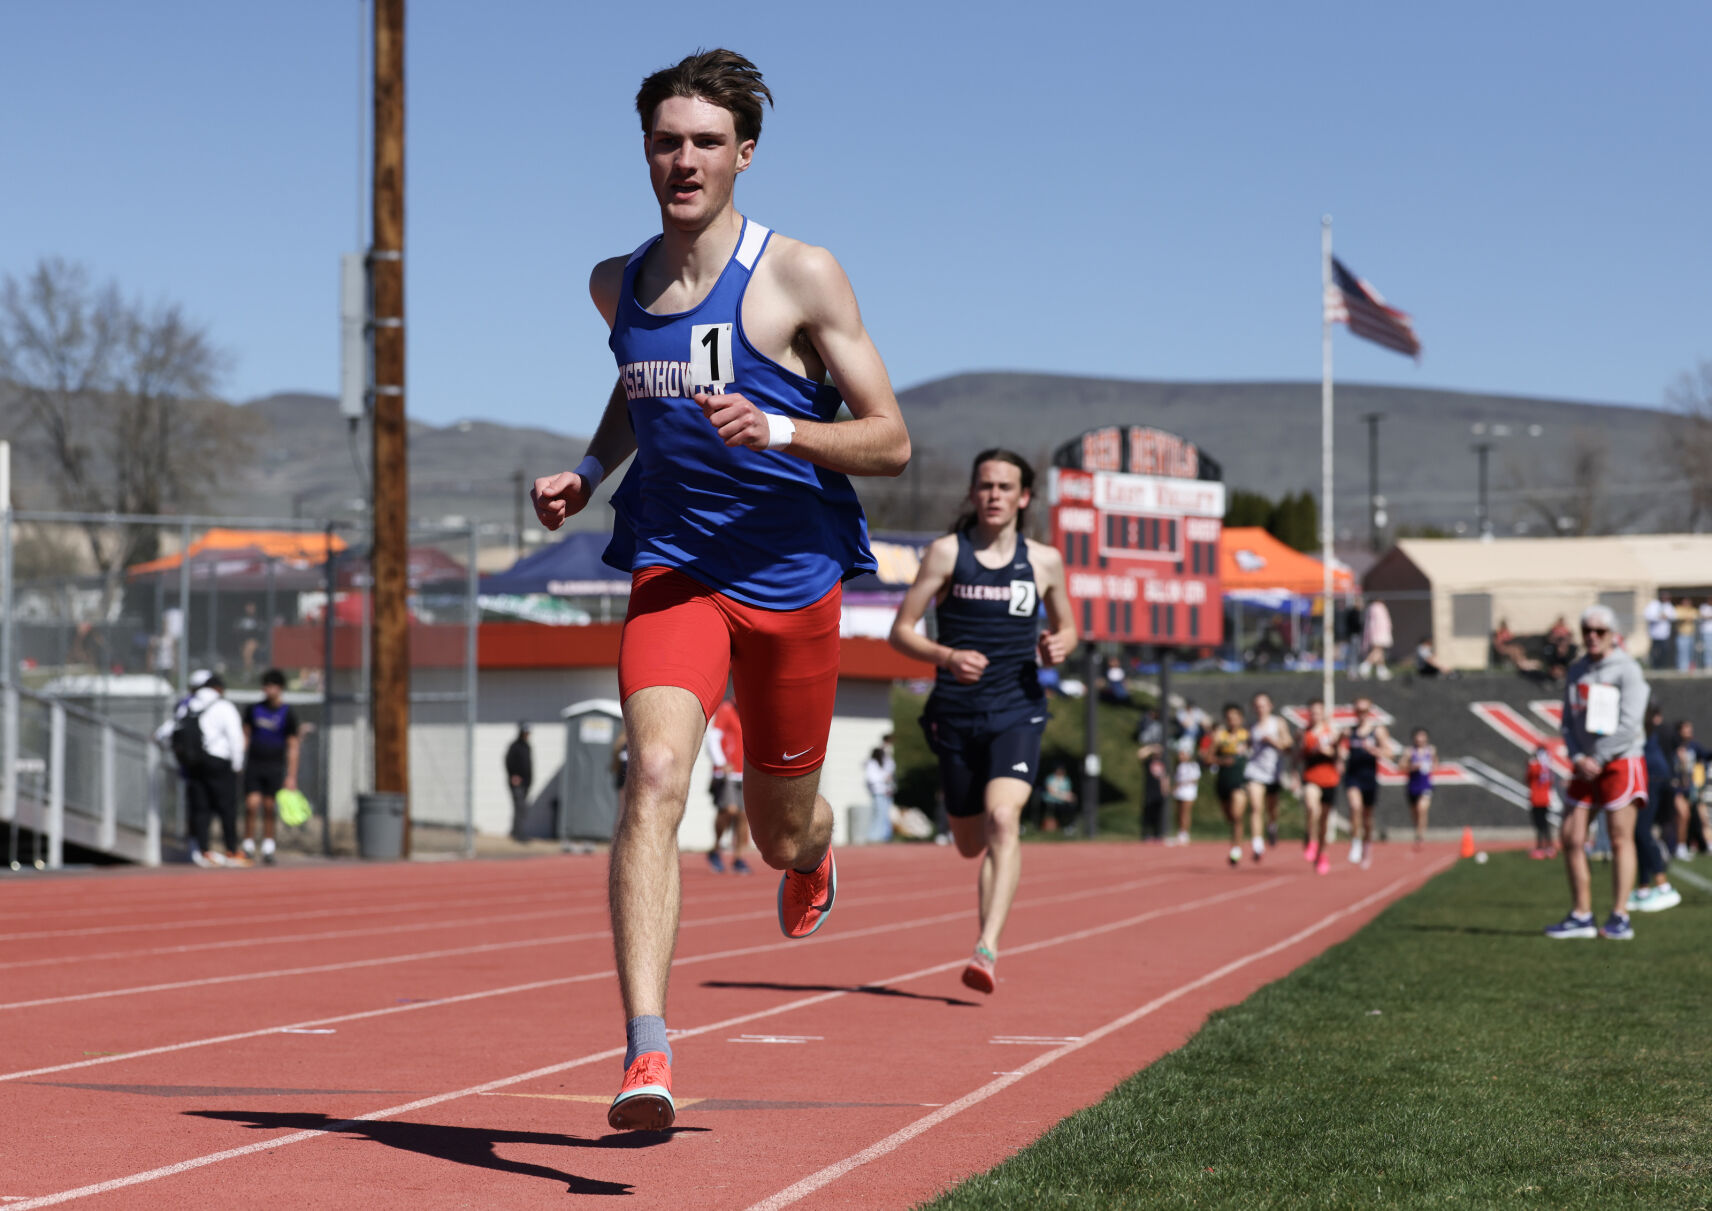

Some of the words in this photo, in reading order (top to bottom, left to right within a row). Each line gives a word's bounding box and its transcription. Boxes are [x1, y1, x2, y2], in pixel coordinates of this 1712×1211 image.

[701, 327, 720, 381] 1
[619, 361, 726, 401] ISENHOW
[953, 584, 1011, 601] ELLENSB
[1015, 585, 1028, 612] 2
